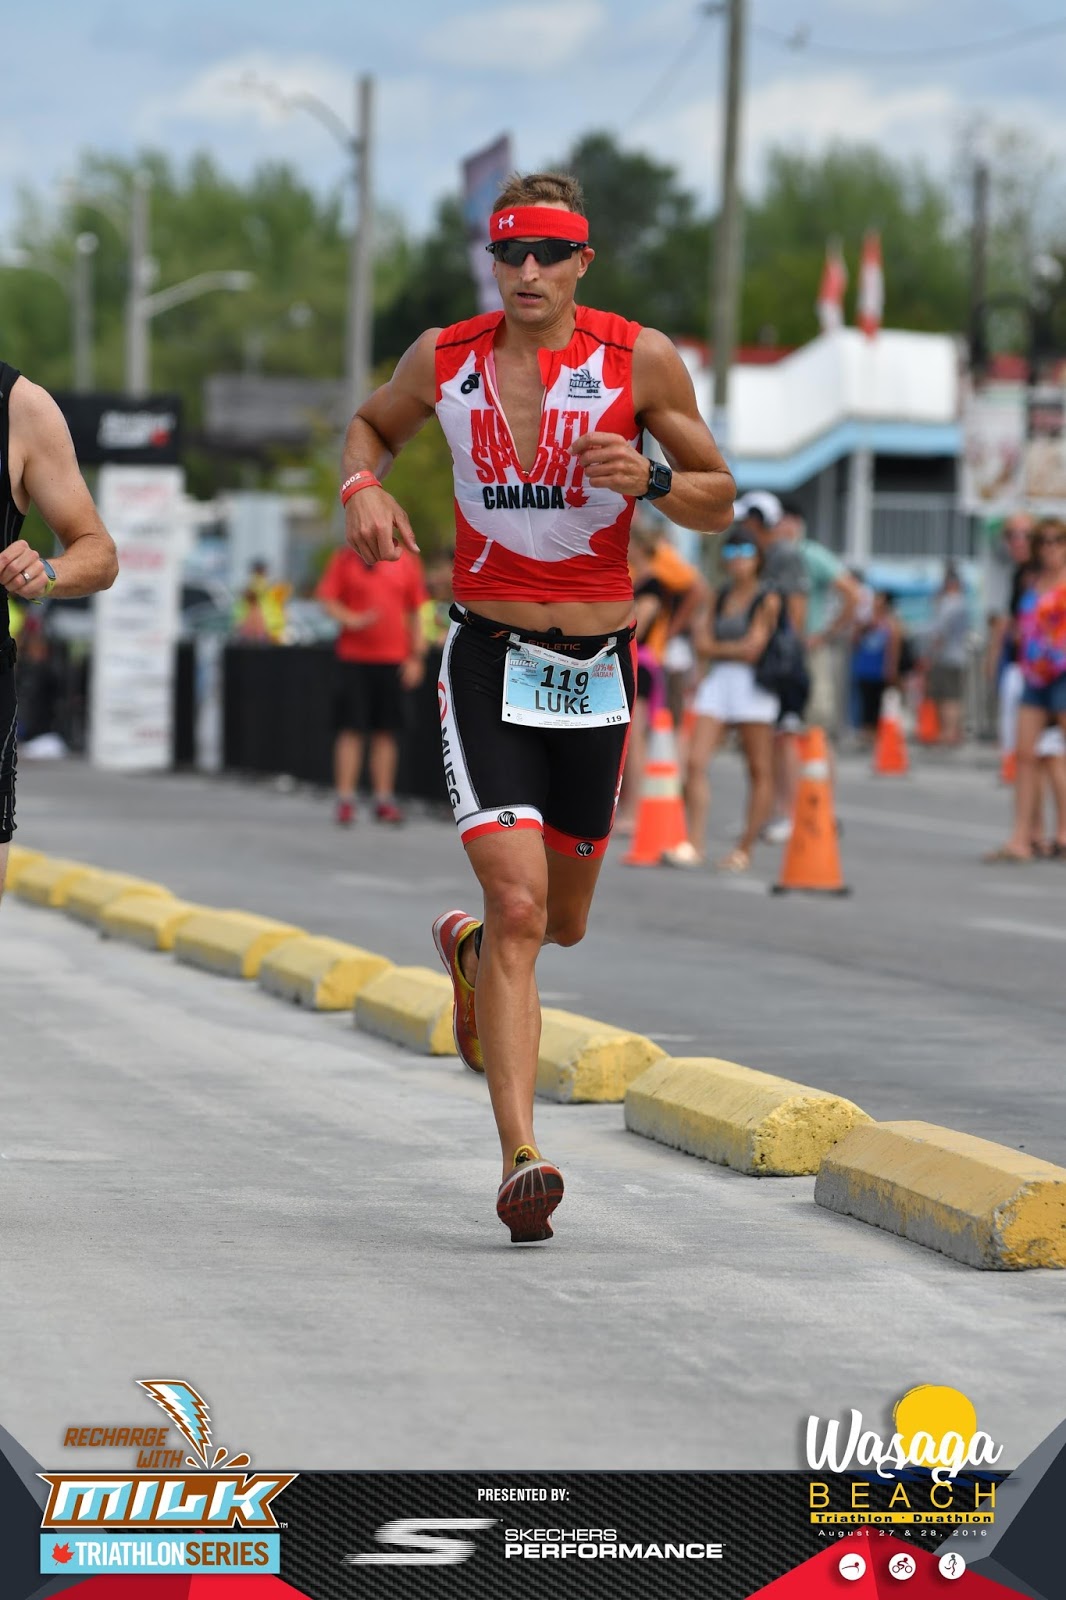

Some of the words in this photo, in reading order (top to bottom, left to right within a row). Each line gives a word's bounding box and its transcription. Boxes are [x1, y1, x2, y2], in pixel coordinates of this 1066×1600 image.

[483, 484, 565, 510] CANADA
[540, 665, 589, 696] 119
[535, 690, 593, 715] LUKE
[605, 715, 622, 724] 119
